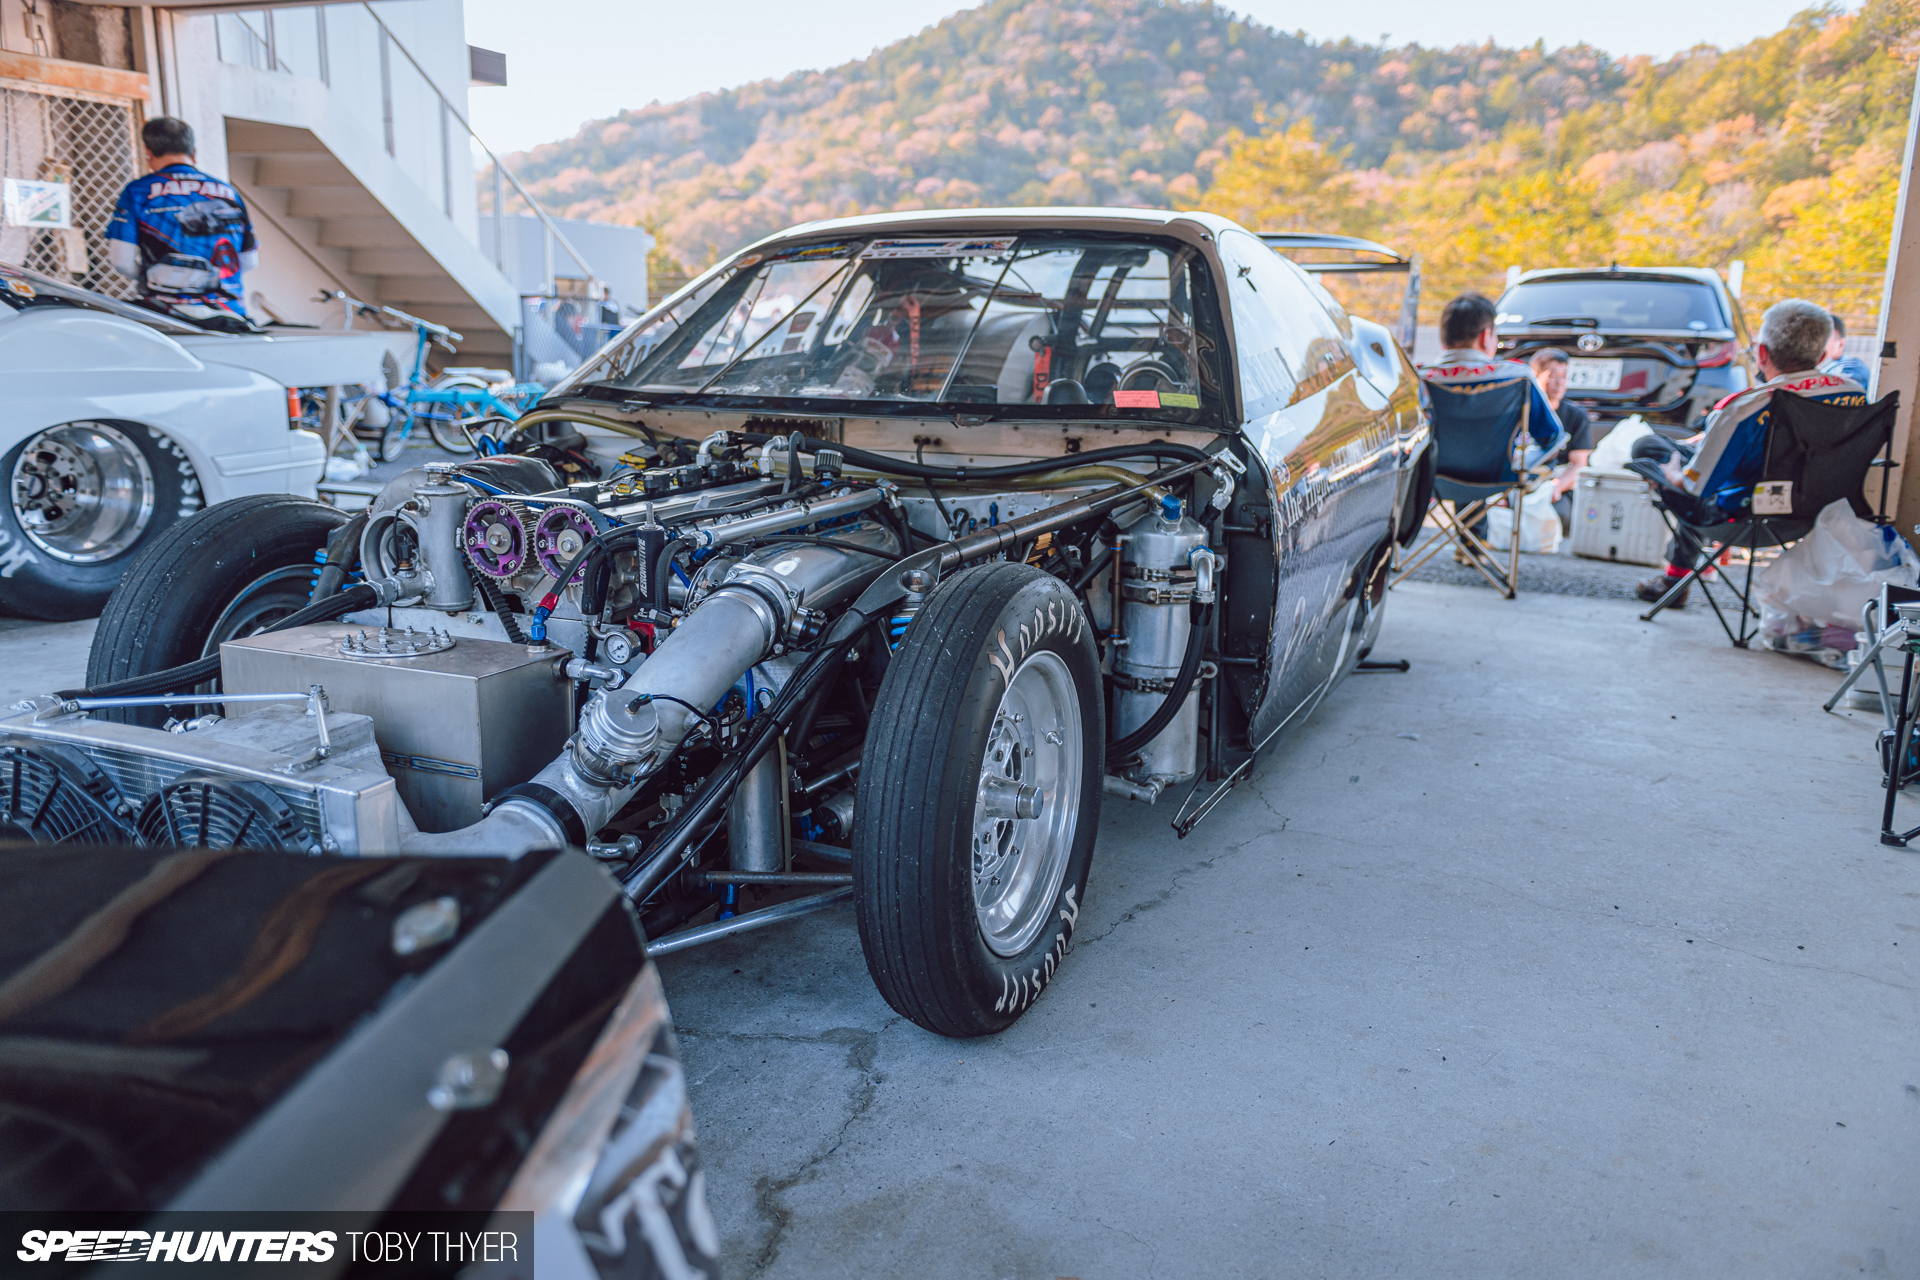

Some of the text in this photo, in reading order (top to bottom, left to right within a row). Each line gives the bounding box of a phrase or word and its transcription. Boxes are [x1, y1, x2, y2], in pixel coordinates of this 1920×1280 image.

[147, 180, 236, 200] JAPAN
[1767, 375, 1847, 397] APAN
[638, 537, 648, 598] AEROMOTIVE
